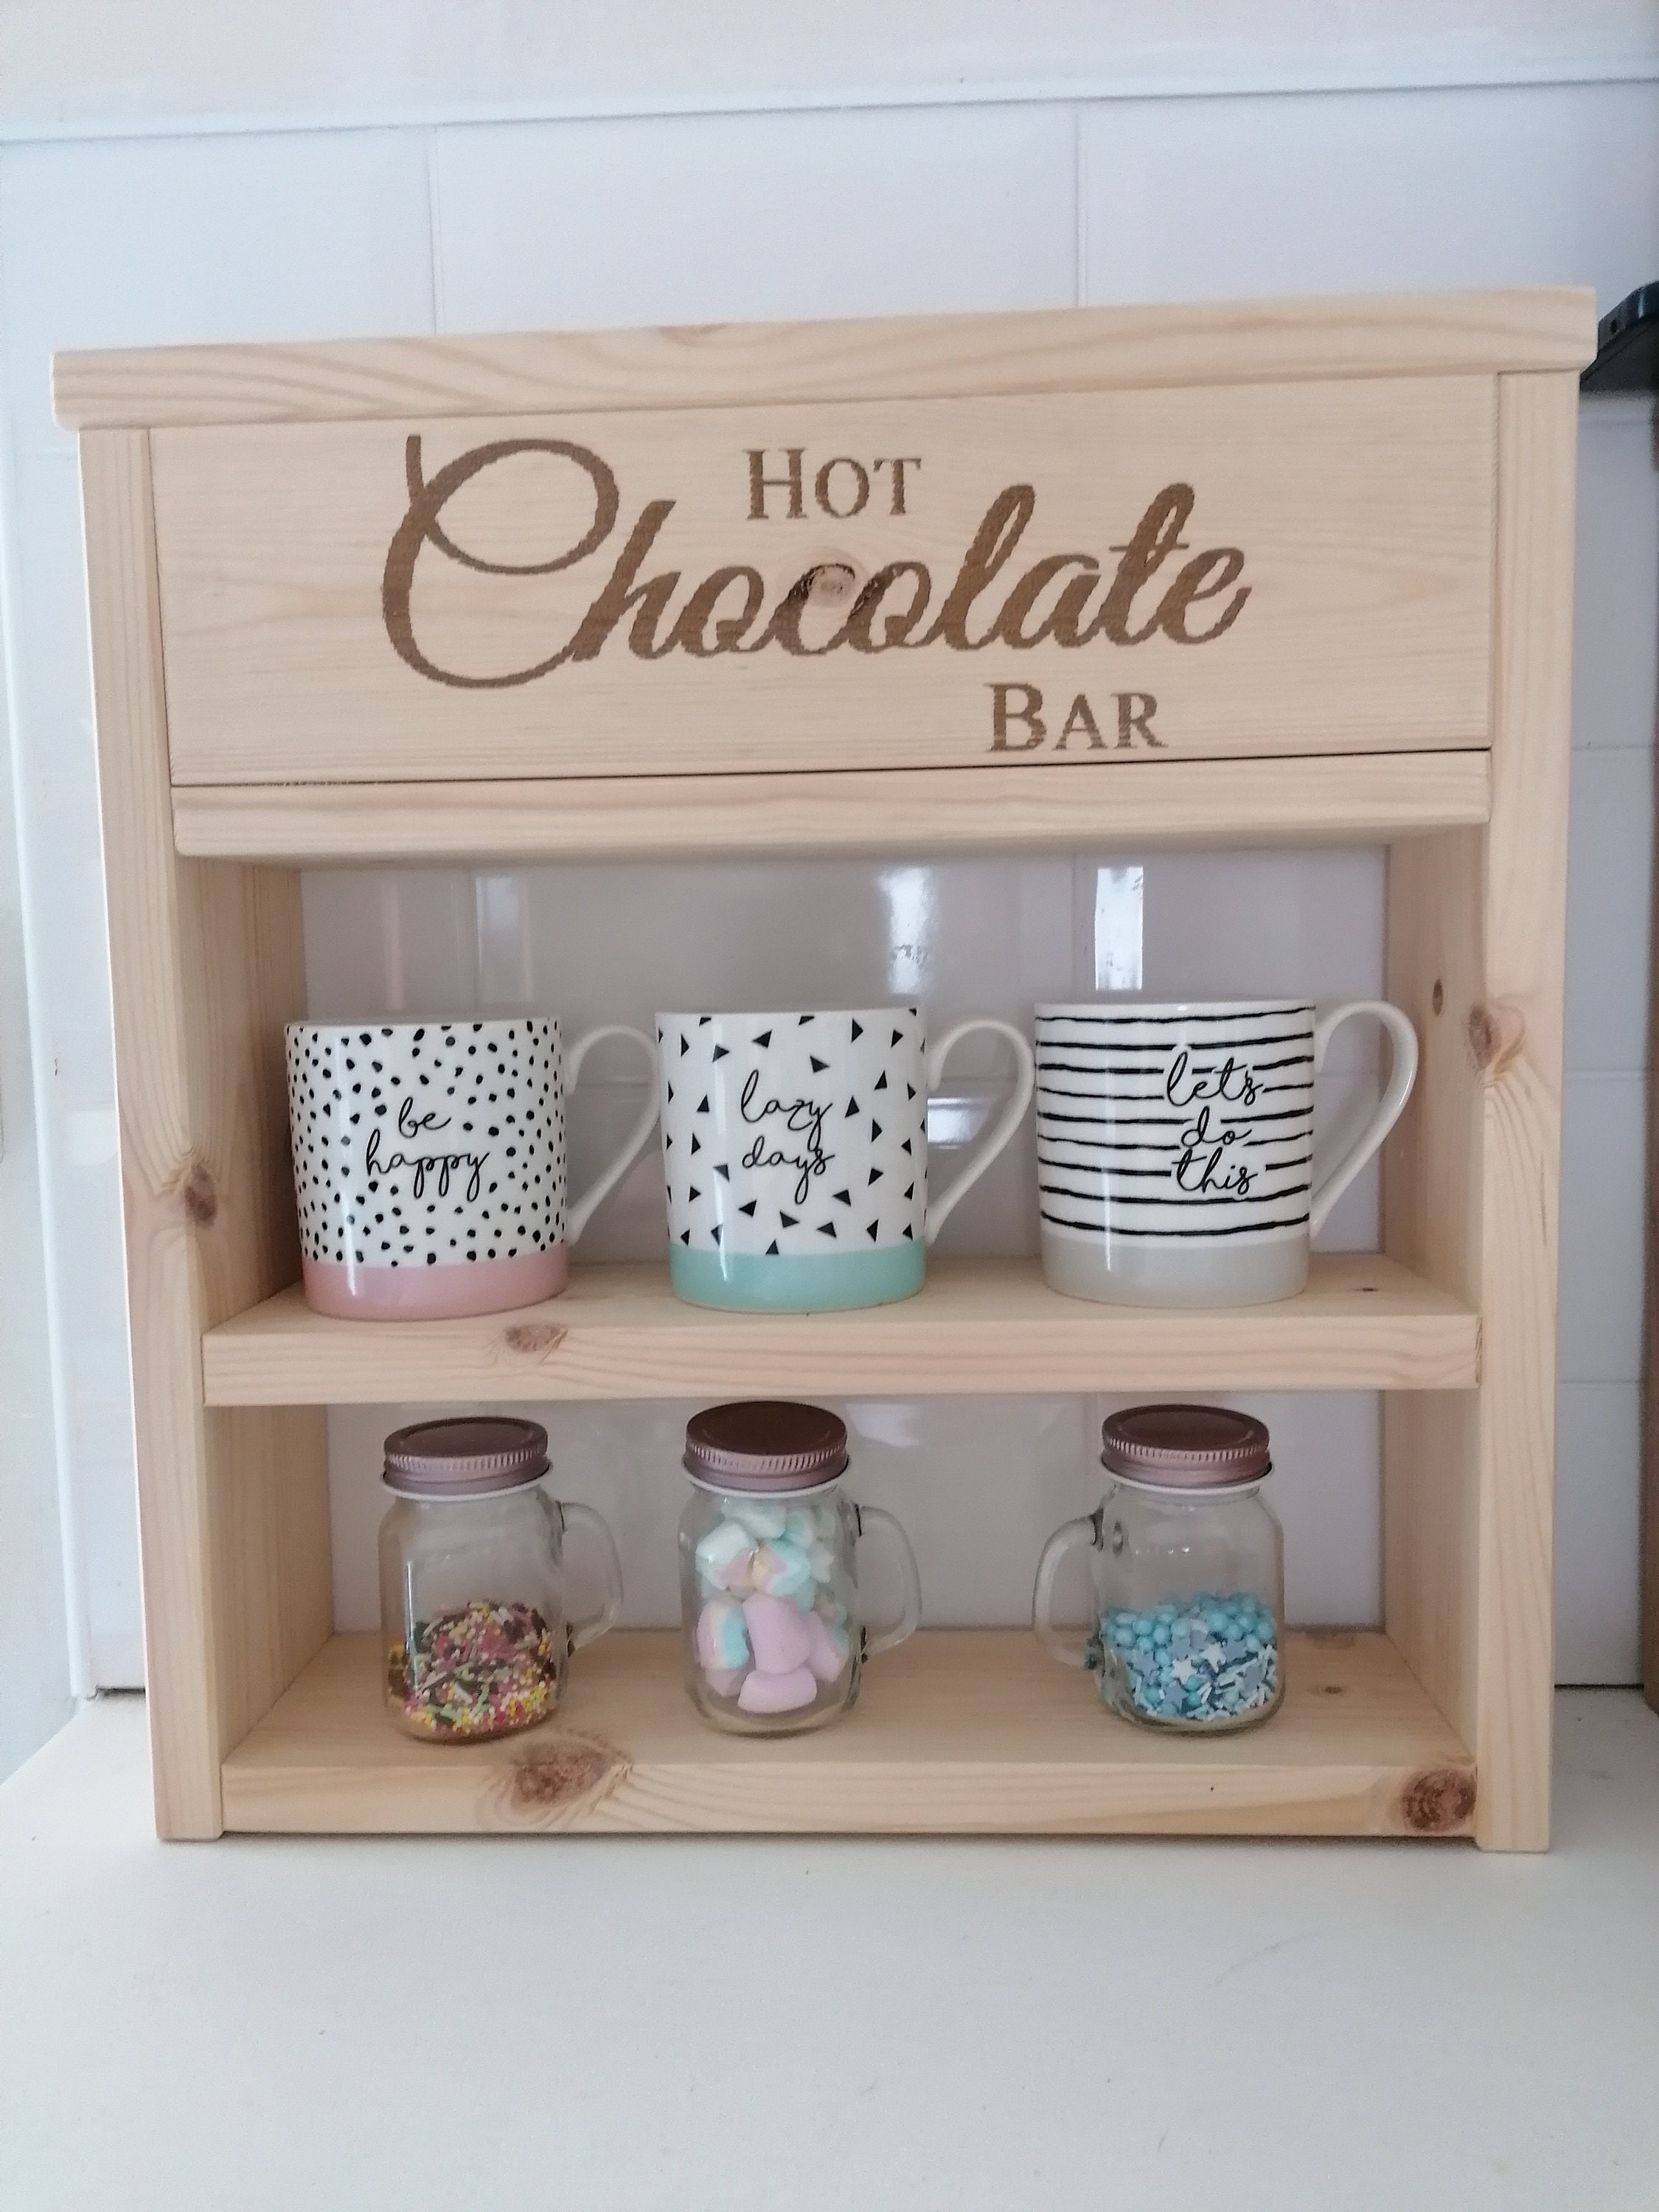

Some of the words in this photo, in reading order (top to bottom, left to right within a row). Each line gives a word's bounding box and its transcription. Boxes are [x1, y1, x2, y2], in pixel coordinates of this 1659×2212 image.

[382, 434, 1251, 689] Chocolate
[398, 1096, 451, 1138] be
[740, 1069, 832, 1152] lazy
[1180, 1105, 1252, 1147] do
[366, 1128, 490, 1202] happy
[742, 1135, 835, 1204] days
[1171, 1147, 1258, 1194] this
